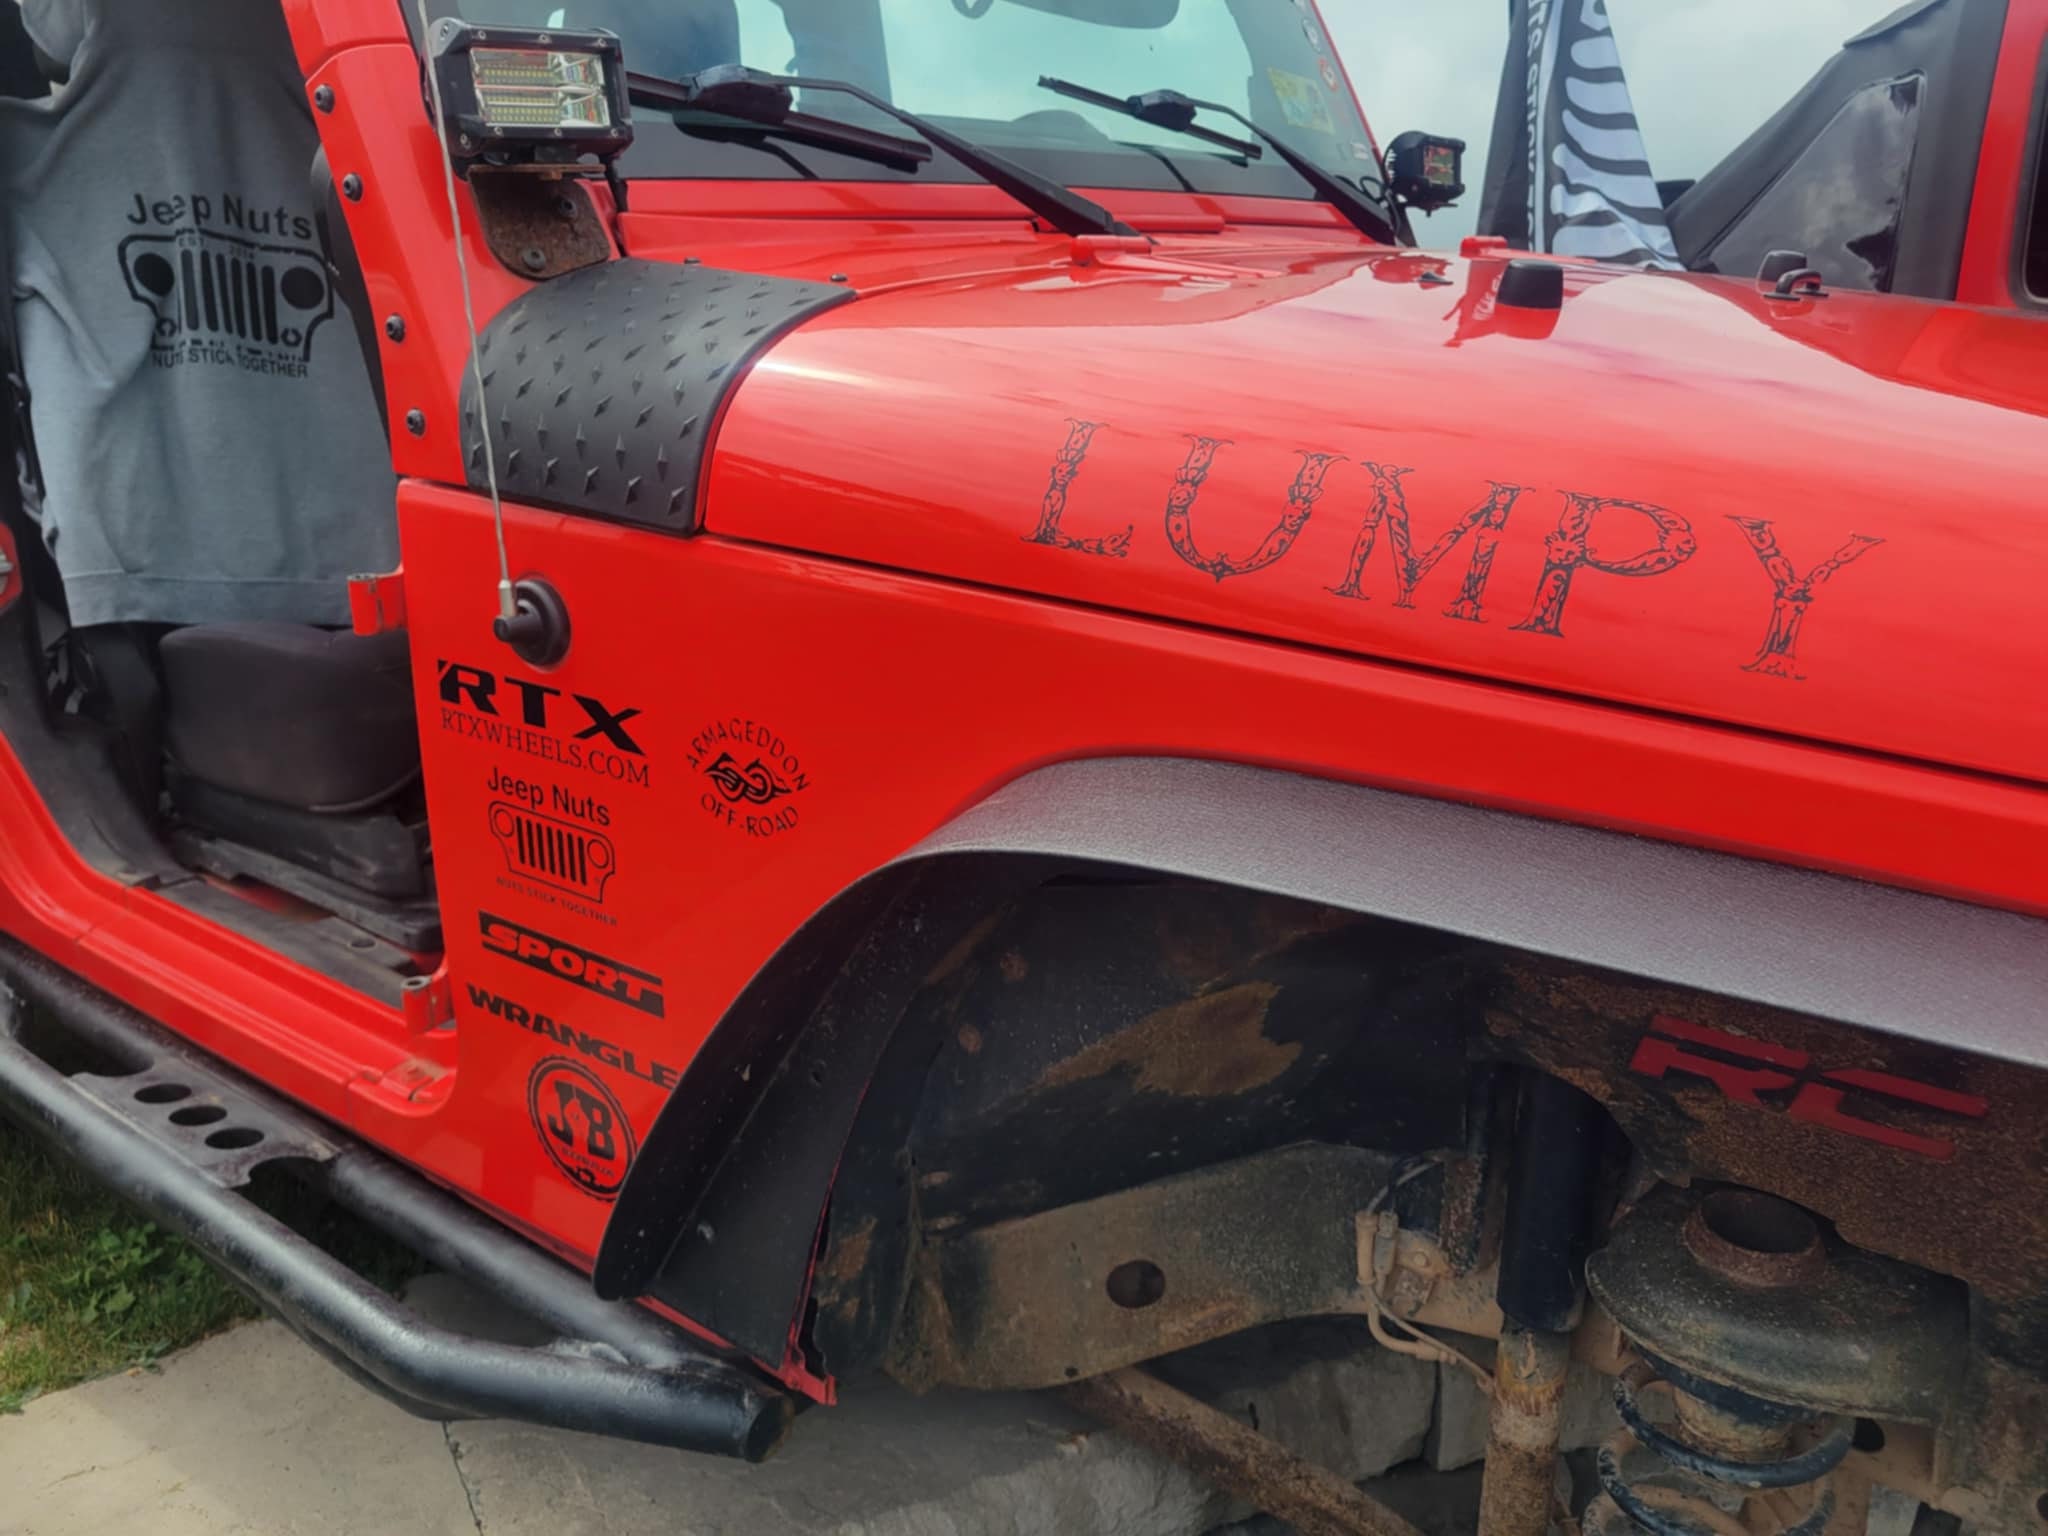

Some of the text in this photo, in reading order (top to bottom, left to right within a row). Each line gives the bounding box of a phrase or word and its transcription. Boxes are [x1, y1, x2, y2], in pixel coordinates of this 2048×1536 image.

[223, 193, 312, 240] Nuts
[1020, 417, 1886, 680] LUMPY
[438, 659, 646, 757] RTX
[440, 707, 651, 788] RTXWHEELS.COM
[686, 717, 811, 791] ARMAGEDDON
[487, 766, 611, 827] Jeep Nuts
[480, 919, 663, 1004] SPORT
